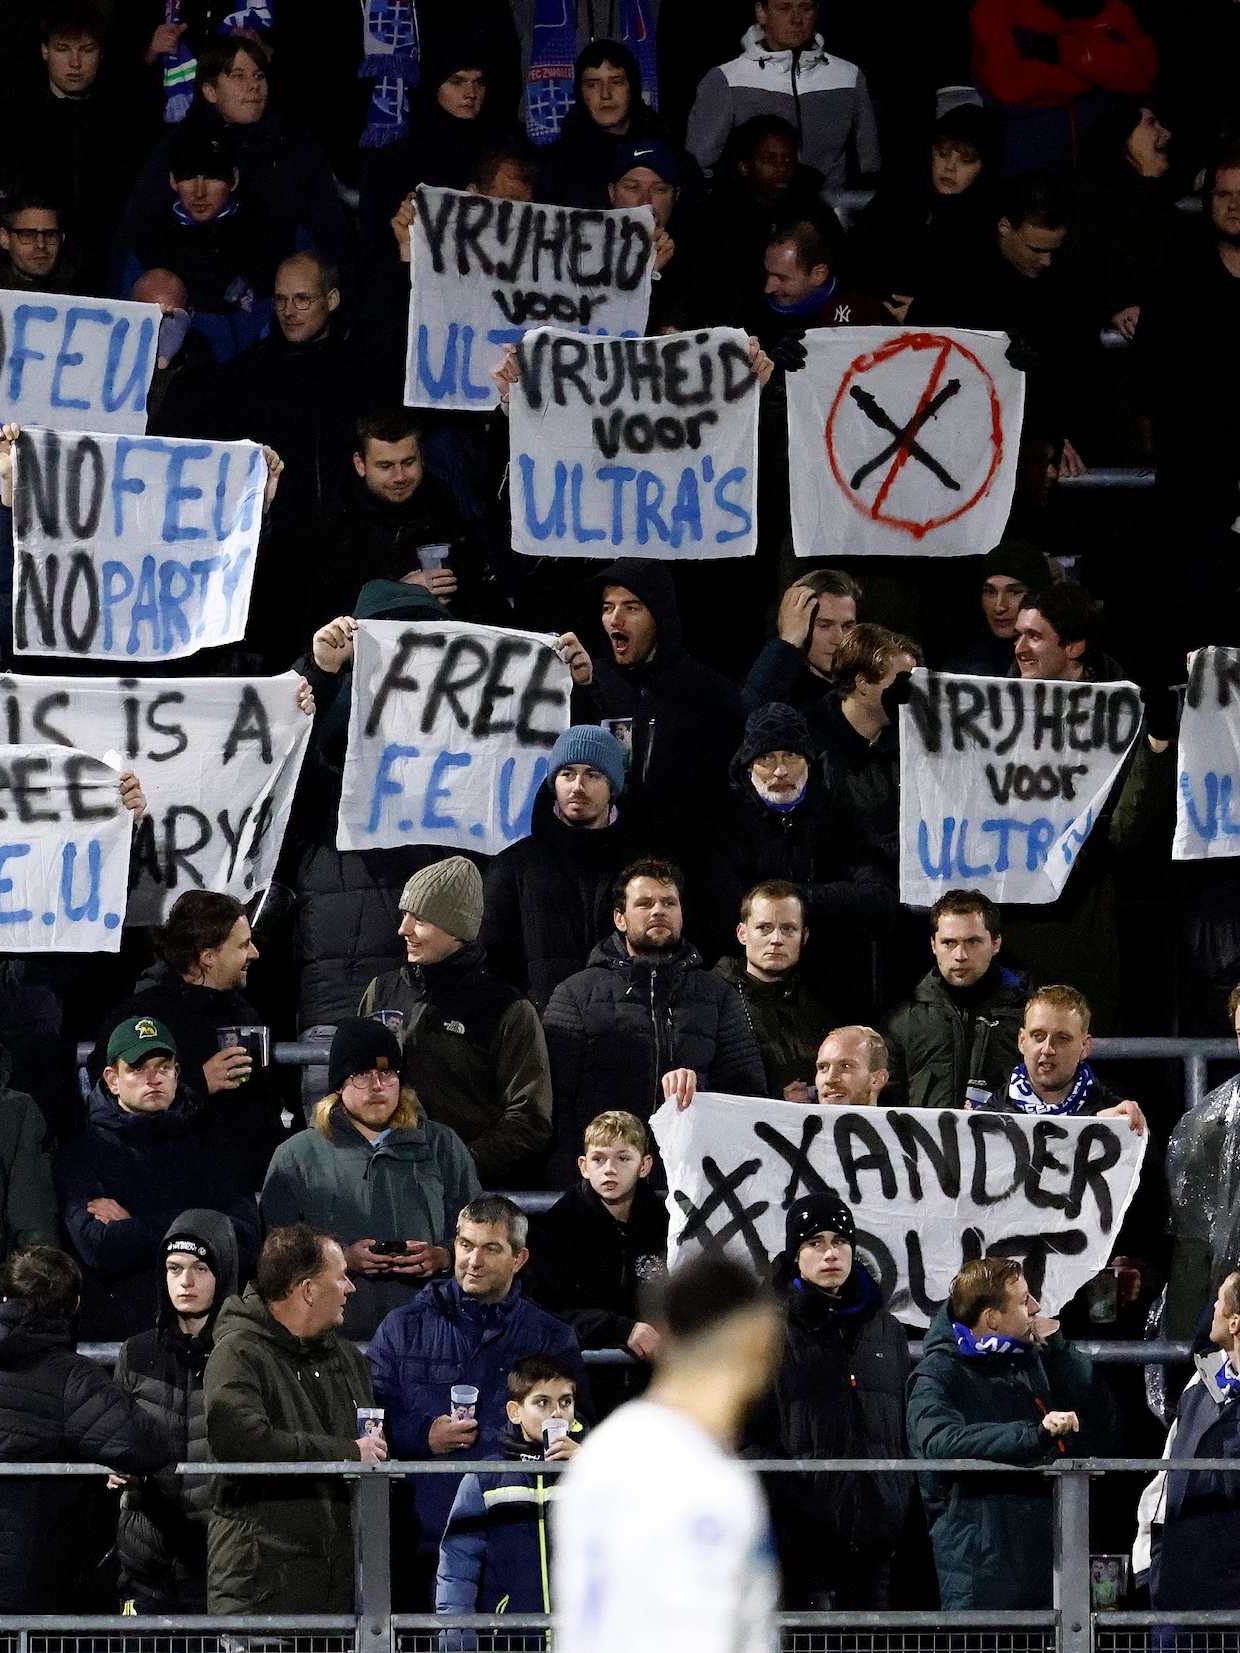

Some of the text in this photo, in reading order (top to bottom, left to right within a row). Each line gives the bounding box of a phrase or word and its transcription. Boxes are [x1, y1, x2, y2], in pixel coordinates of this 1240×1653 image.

[413, 189, 652, 290] VRIJHEID
[491, 290, 607, 326] voor
[7, 304, 153, 412] FEU
[592, 409, 718, 459] voor
[14, 430, 105, 539] NO
[112, 436, 262, 542] FEU
[519, 454, 752, 548] ULTRA'S
[15, 549, 250, 654] NO PARTY
[223, 685, 273, 765] A
[364, 629, 566, 749] FREE
[909, 675, 1139, 756] VRIJHEID
[986, 762, 1088, 805] voor
[754, 1110, 1121, 1234] XANDER
